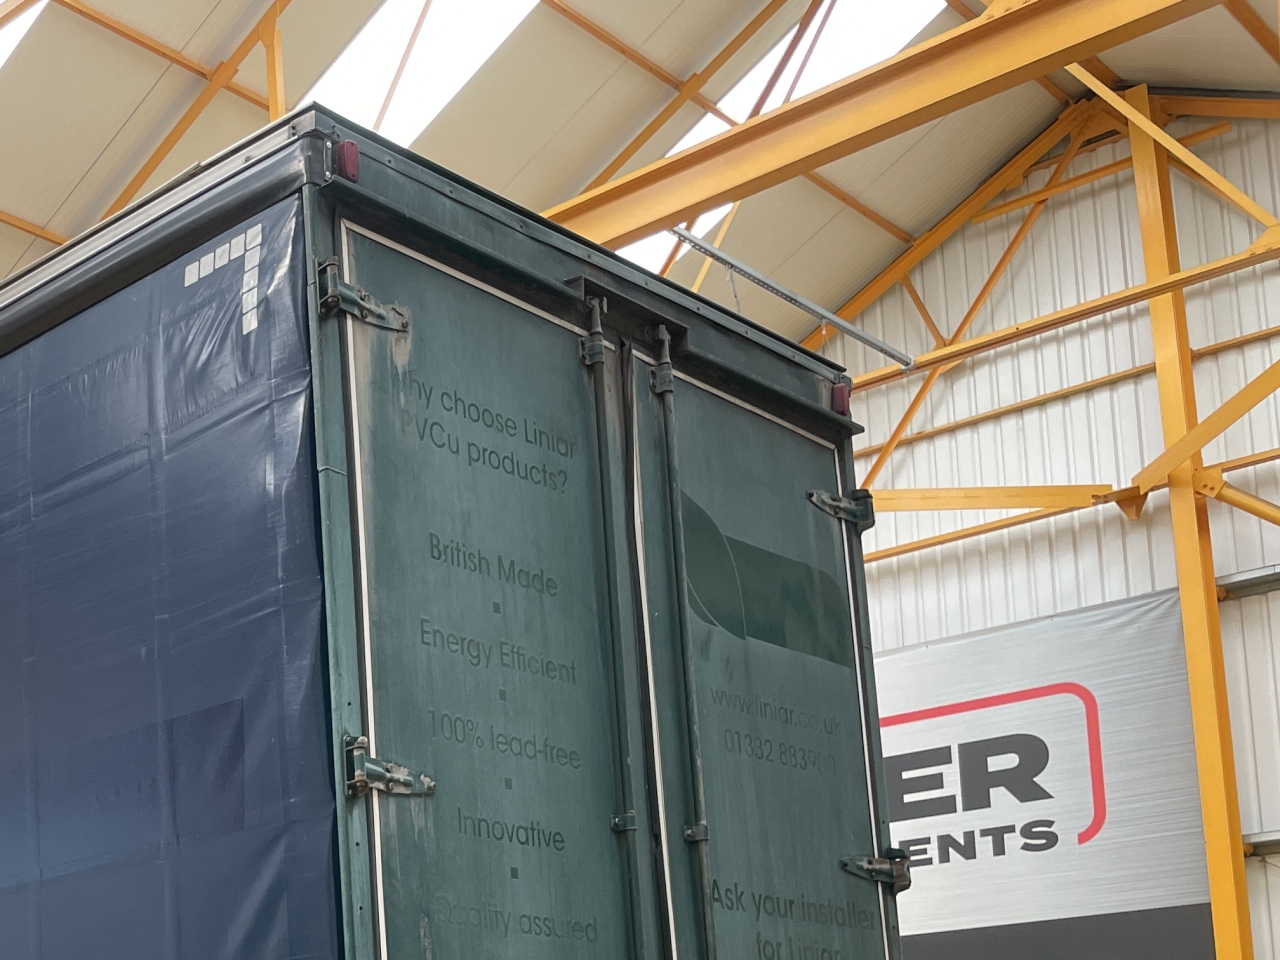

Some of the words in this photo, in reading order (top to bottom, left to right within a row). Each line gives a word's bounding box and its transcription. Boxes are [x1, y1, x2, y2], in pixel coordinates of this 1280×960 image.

[400, 408, 460, 455] PVCu
[467, 440, 568, 495] products?
[440, 389, 517, 438] choose
[523, 417, 577, 460] Liniar
[429, 532, 491, 578] British
[497, 554, 558, 598] Made
[420, 617, 493, 669] Energy
[500, 640, 576, 685] Efficient
[428, 708, 484, 749] 100%
[490, 725, 581, 770] lead-free
[724, 728, 774, 764] 01332
[883, 733, 1055, 822] ER
[457, 807, 566, 852] Innovative
[899, 819, 1059, 868] ENTS
[430, 893, 511, 938] Quality
[519, 913, 597, 943] assured
[712, 878, 747, 913] Ask
[751, 891, 795, 922] your
[801, 893, 876, 932] installer
